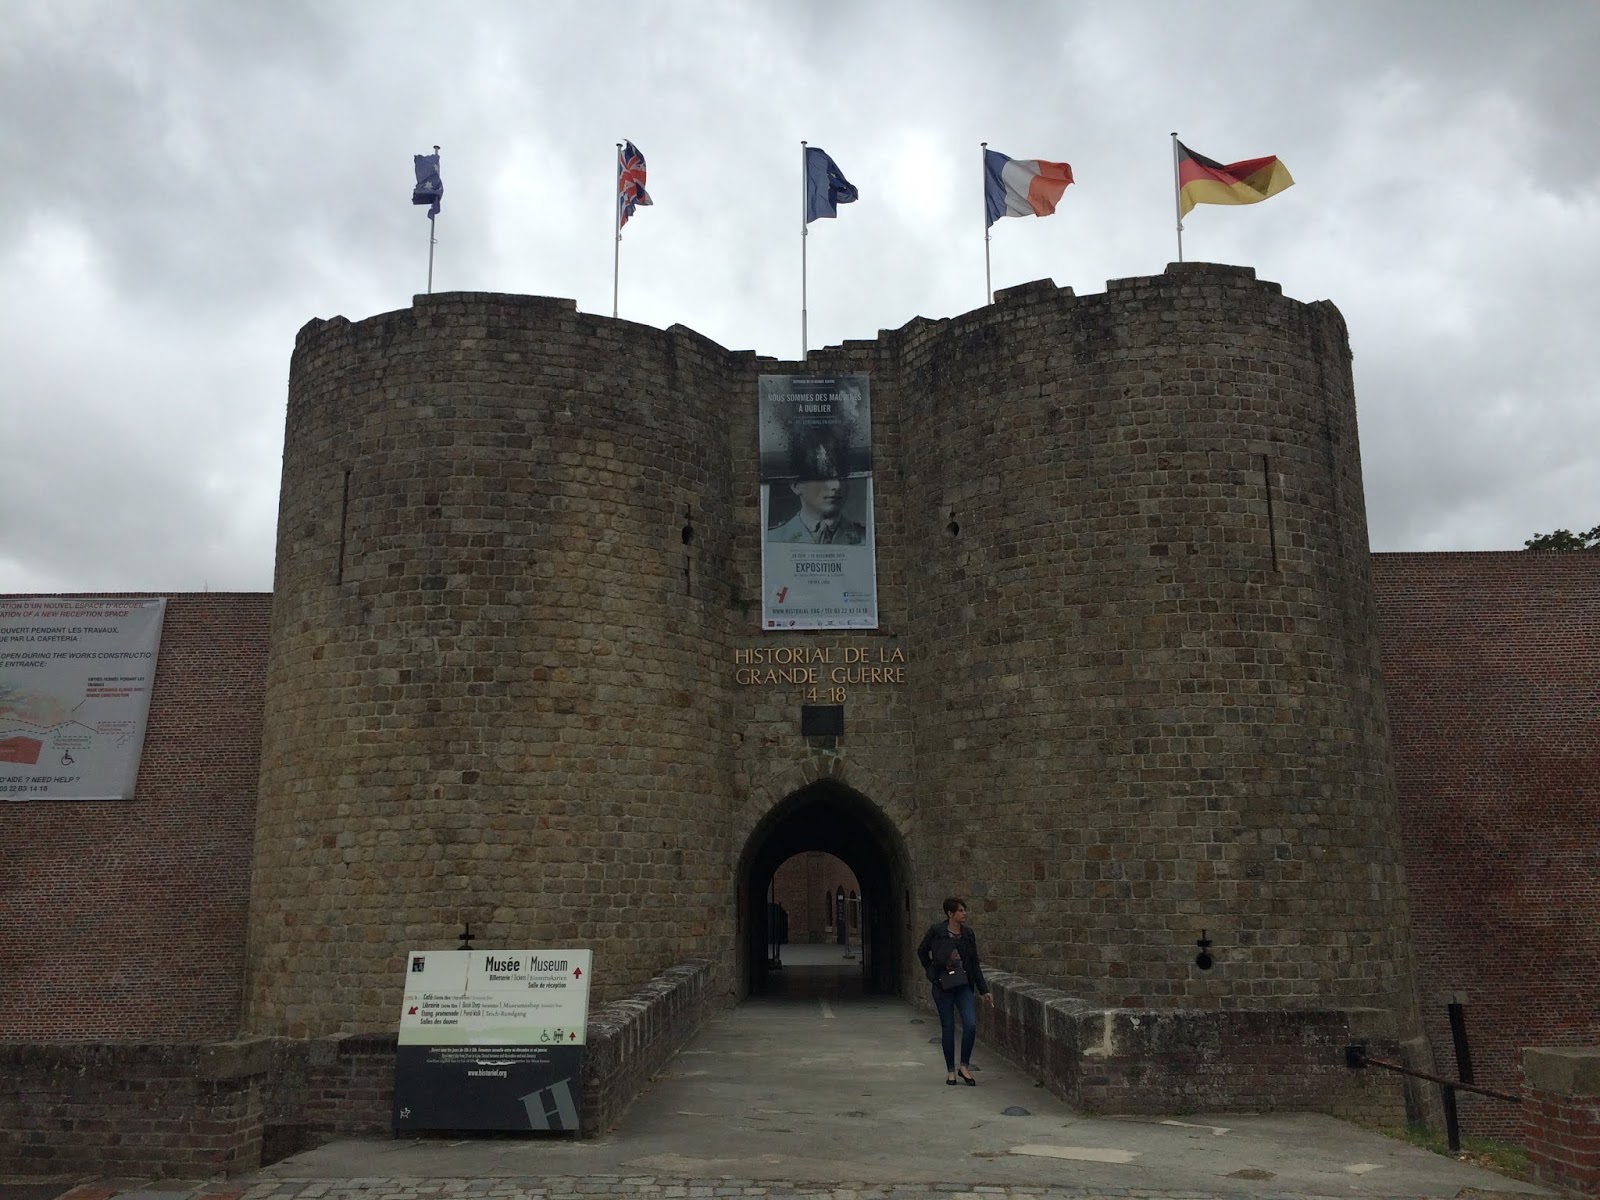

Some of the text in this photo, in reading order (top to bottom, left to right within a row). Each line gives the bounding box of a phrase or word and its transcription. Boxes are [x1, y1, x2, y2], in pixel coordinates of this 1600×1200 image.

[786, 394, 814, 402] SOMMES
[816, 394, 828, 402] DES
[804, 404, 832, 412] OUBLIER
[796, 562, 842, 572] EXPOSITION
[735, 647, 904, 664] HISTORIAL DE LA
[736, 668, 905, 685] GRANDE GUERRE
[802, 686, 847, 702] 14-18
[485, 956, 568, 972] Musée Museum
[468, 1069, 508, 1078] www.historial.org
